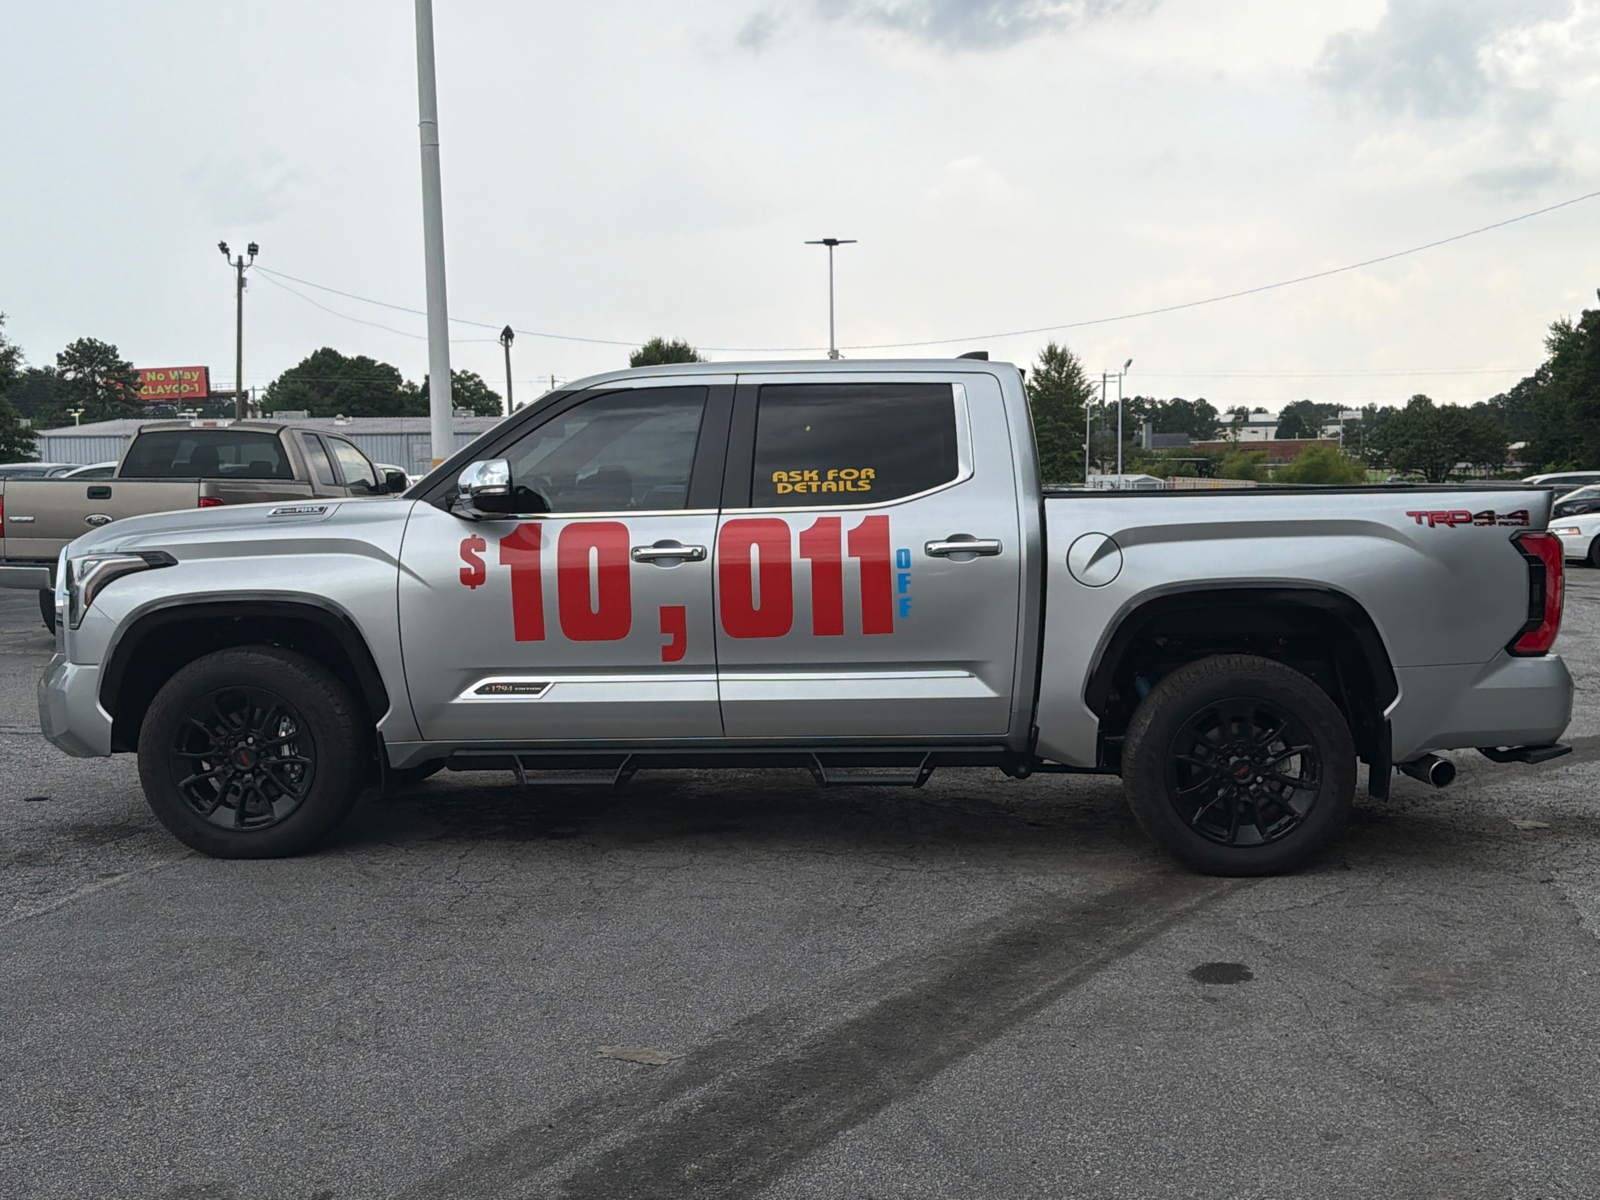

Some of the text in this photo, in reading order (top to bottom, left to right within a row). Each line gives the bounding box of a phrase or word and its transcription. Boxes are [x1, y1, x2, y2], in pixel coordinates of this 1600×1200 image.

[146, 371, 165, 381] No
[169, 370, 199, 381] Way
[772, 468, 875, 482] ASK FOR
[777, 480, 871, 494] DETAILS
[1406, 509, 1472, 528] TRD
[896, 548, 913, 619] OFF
